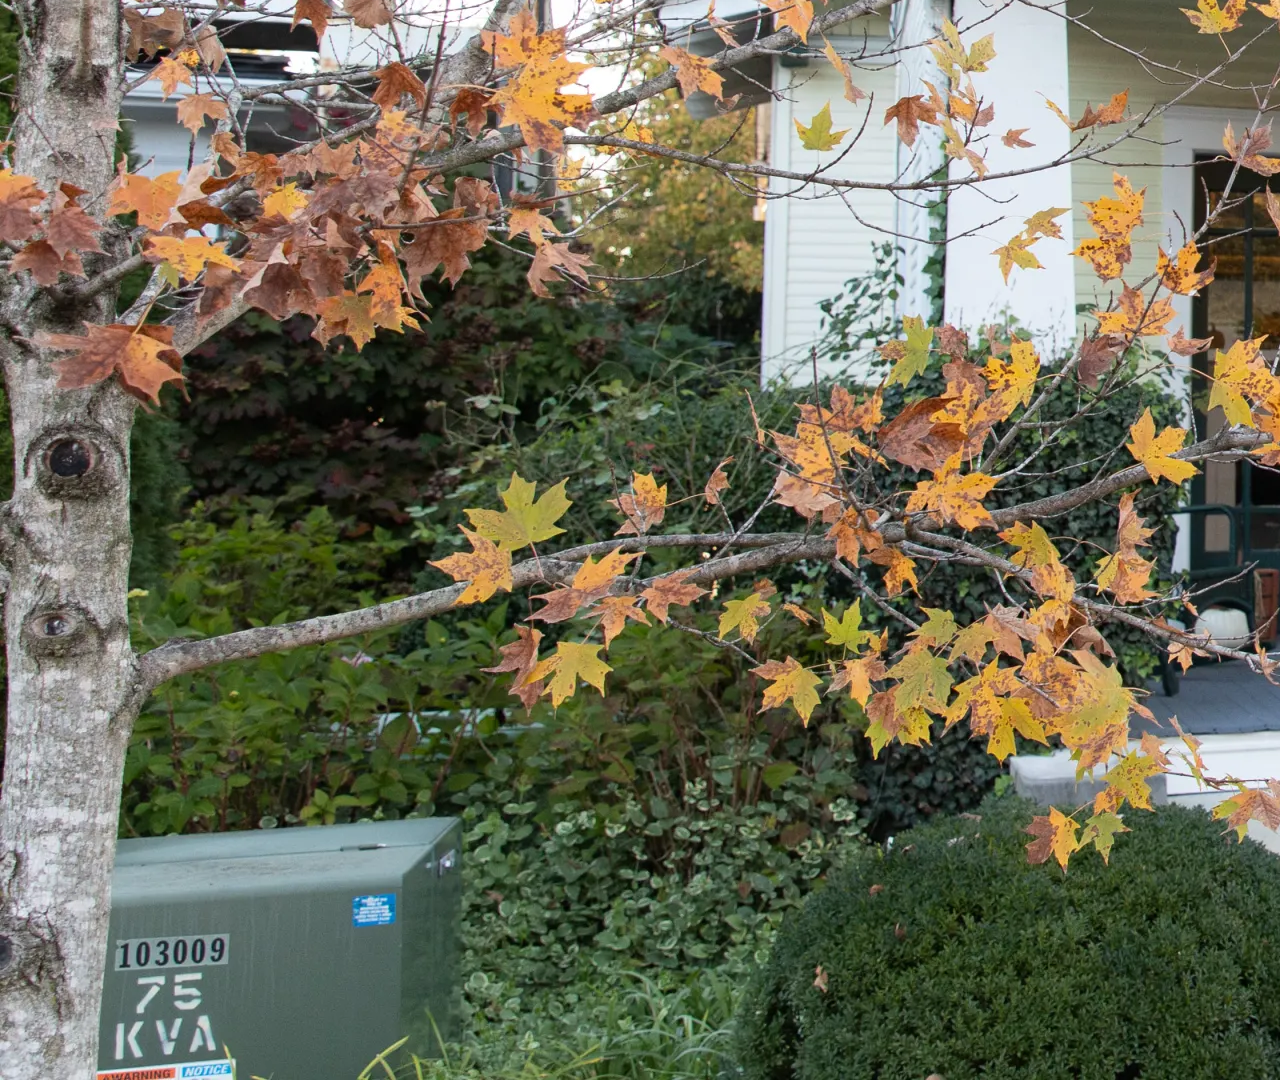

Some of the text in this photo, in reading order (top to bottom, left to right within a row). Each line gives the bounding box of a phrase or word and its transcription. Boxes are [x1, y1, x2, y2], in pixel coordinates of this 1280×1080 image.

[119, 937, 226, 968] 103009
[136, 972, 203, 1014] 75
[115, 1015, 216, 1060] KVA
[112, 1069, 171, 1080] WARNING
[184, 1065, 229, 1077] NOTICE
